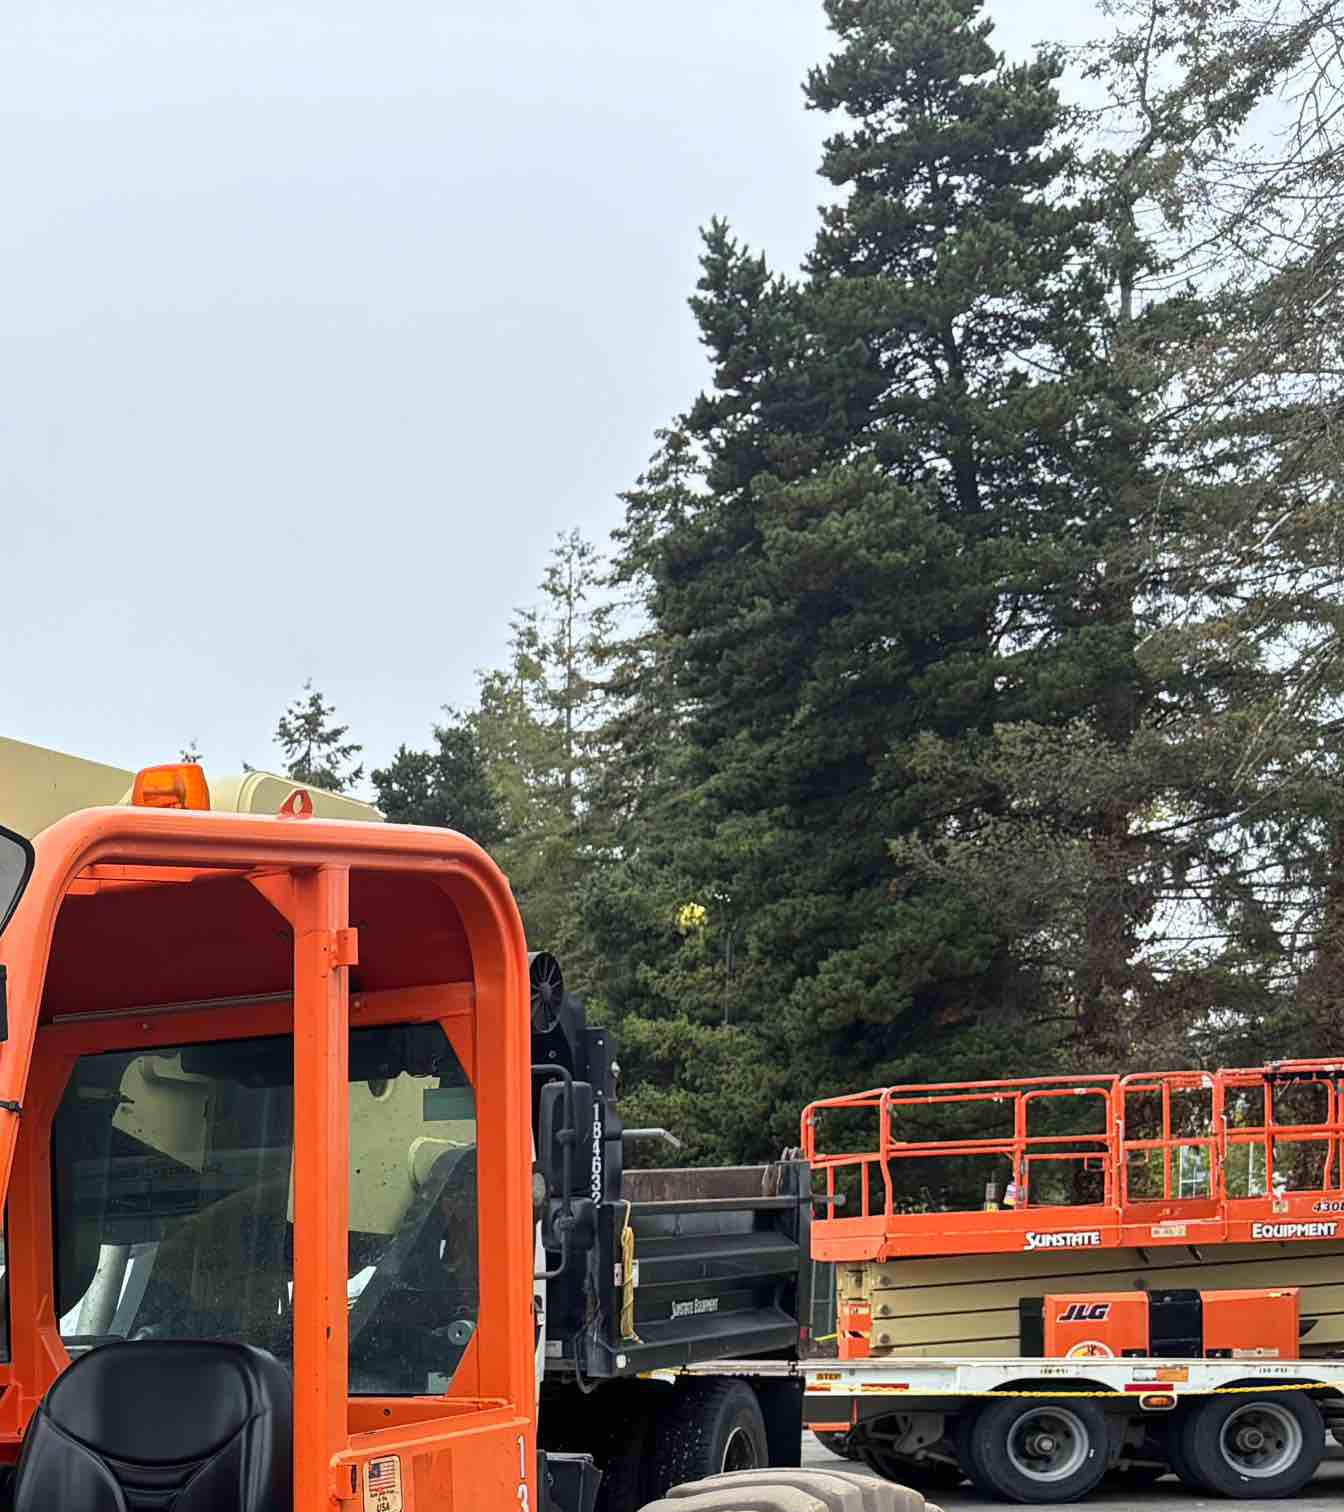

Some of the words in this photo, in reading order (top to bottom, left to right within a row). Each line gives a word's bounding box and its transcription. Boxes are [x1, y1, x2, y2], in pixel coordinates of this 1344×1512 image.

[1024, 1231, 1100, 1250] SUNSTATE
[1251, 1222, 1338, 1238] EQUIPMENT
[1057, 1303, 1110, 1322] JLG
[376, 1502, 390, 1512] USA
